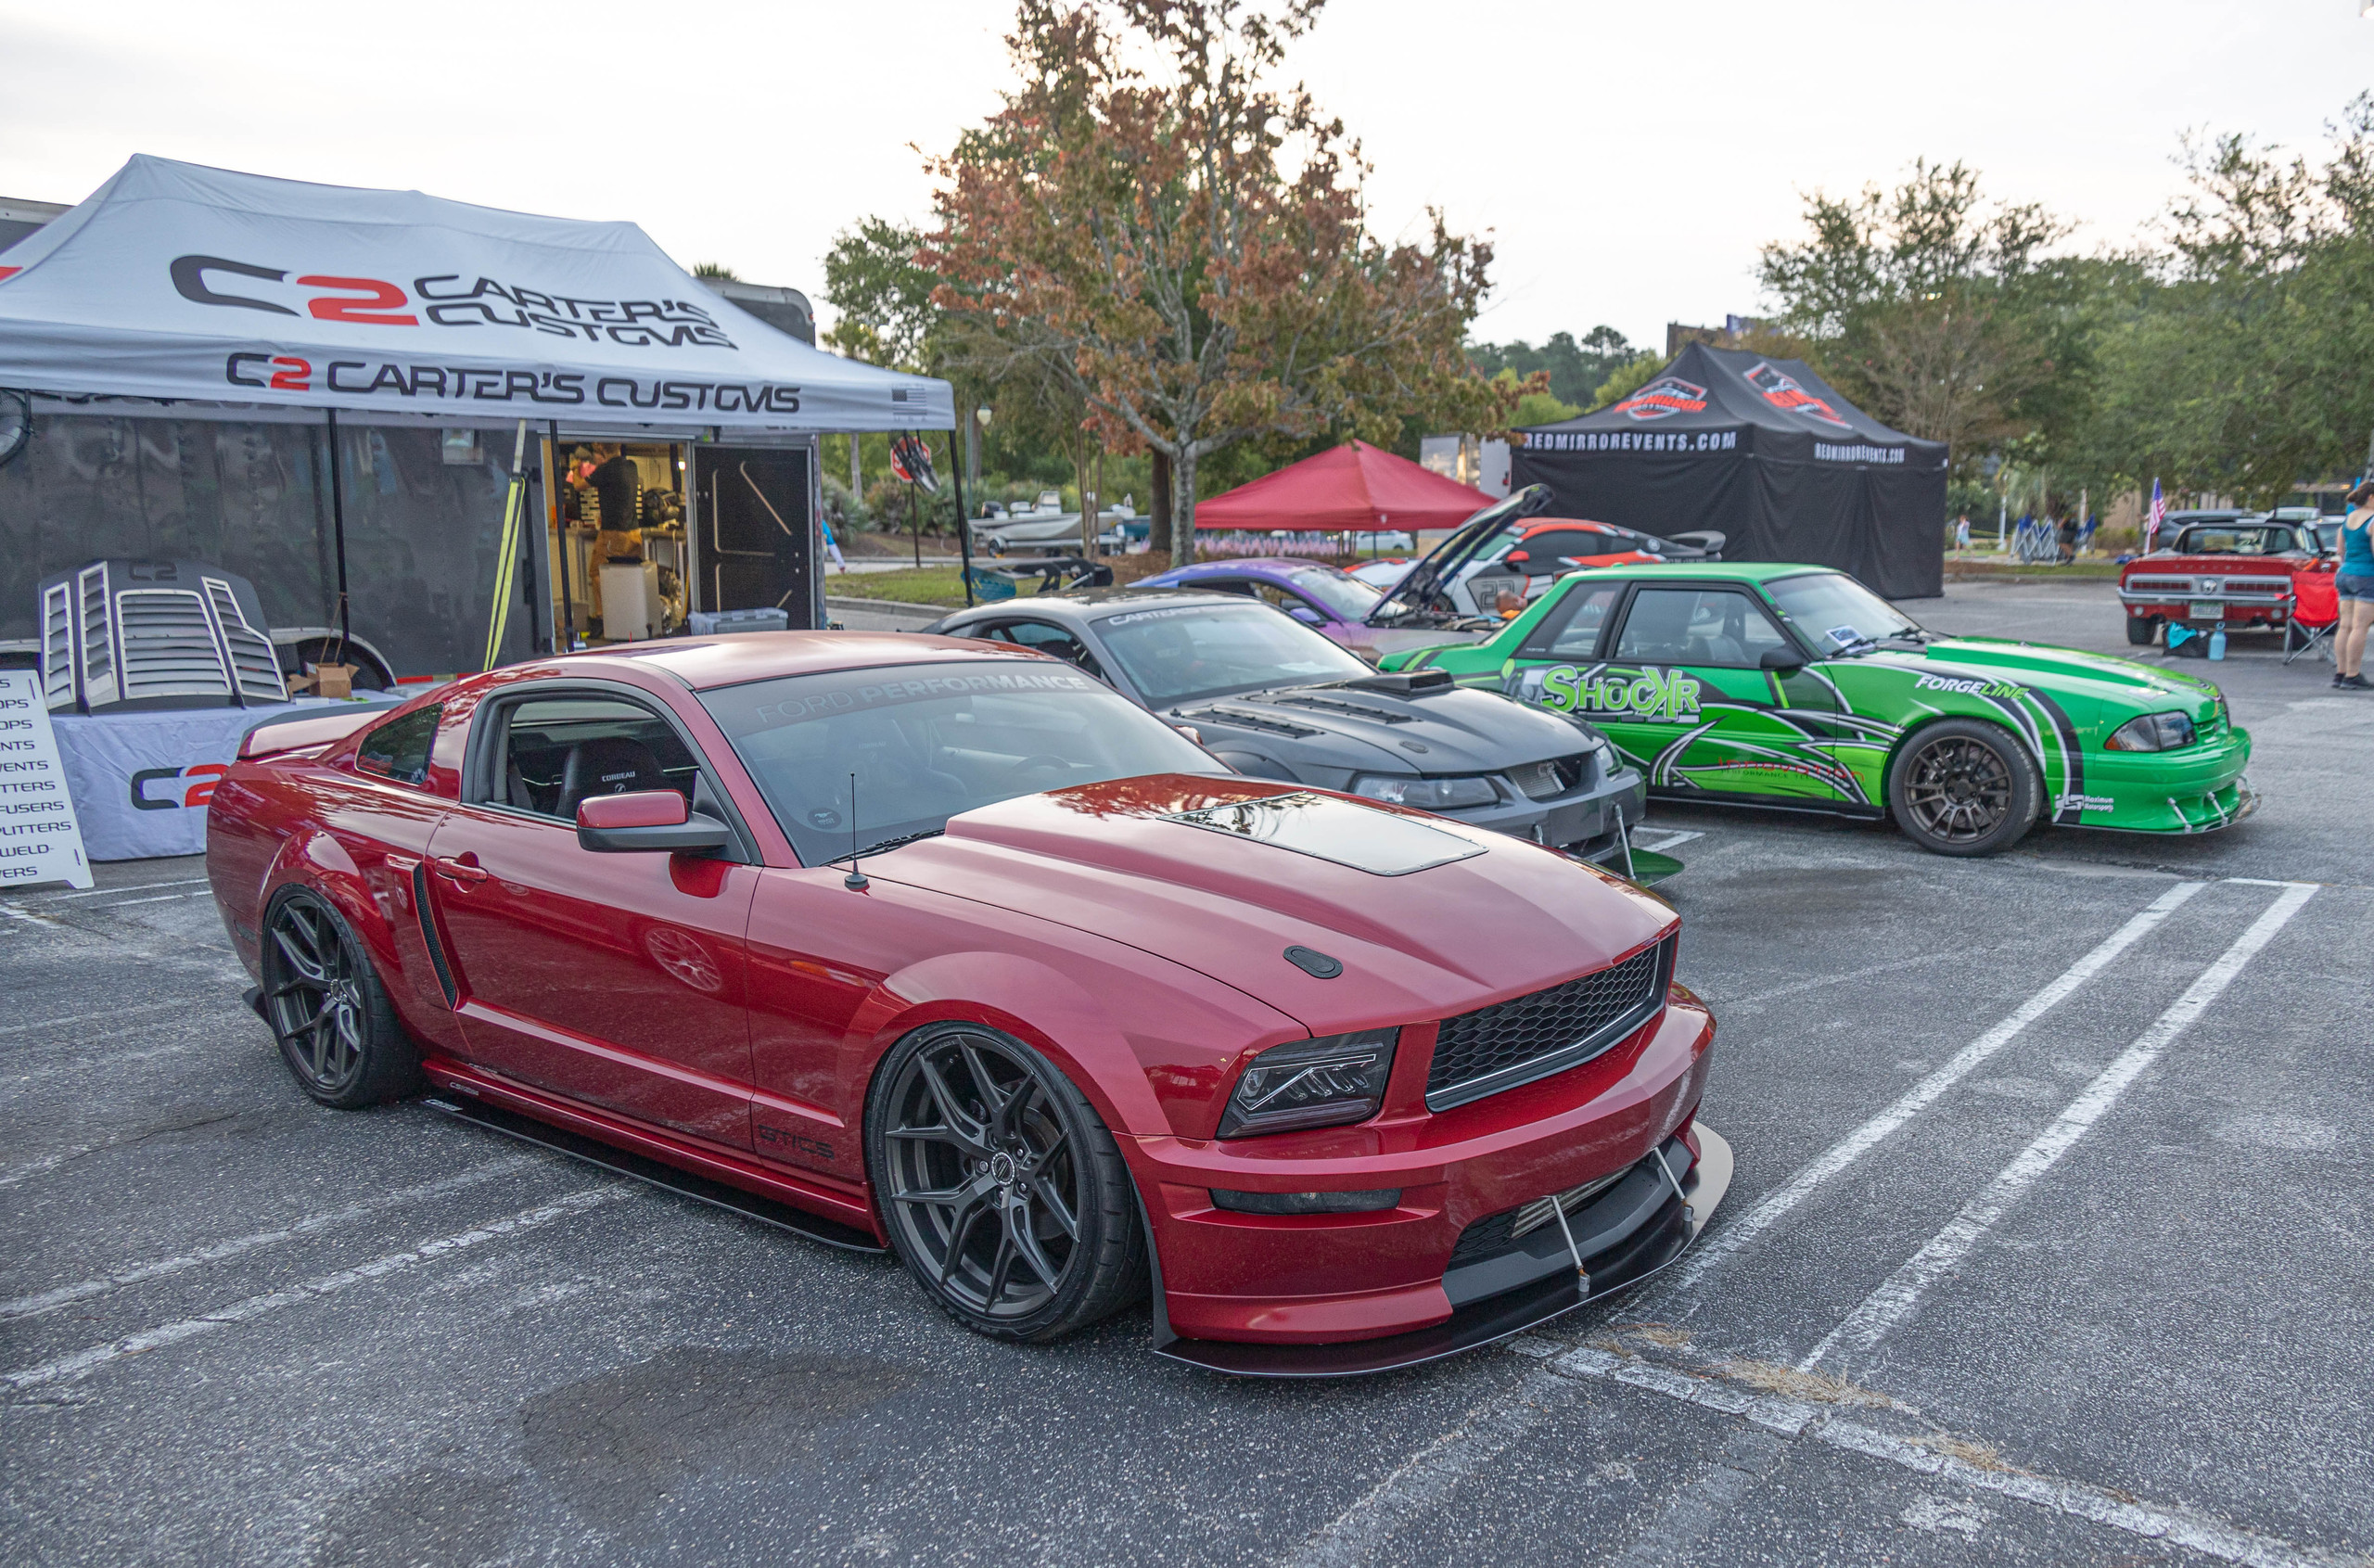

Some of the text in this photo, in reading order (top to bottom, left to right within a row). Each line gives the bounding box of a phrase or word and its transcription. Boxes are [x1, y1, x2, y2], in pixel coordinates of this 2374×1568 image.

[170, 254, 718, 329] C2 CARTER'S
[426, 302, 739, 350] CUSTOMS
[226, 352, 801, 414] C2 CARTER'S CUSTOMS
[756, 675, 1086, 723] FORD PERFORMANCE
[1915, 674, 2030, 700] FORGELINE
[131, 763, 229, 810] C2
[601, 771, 637, 783] CORBEAU
